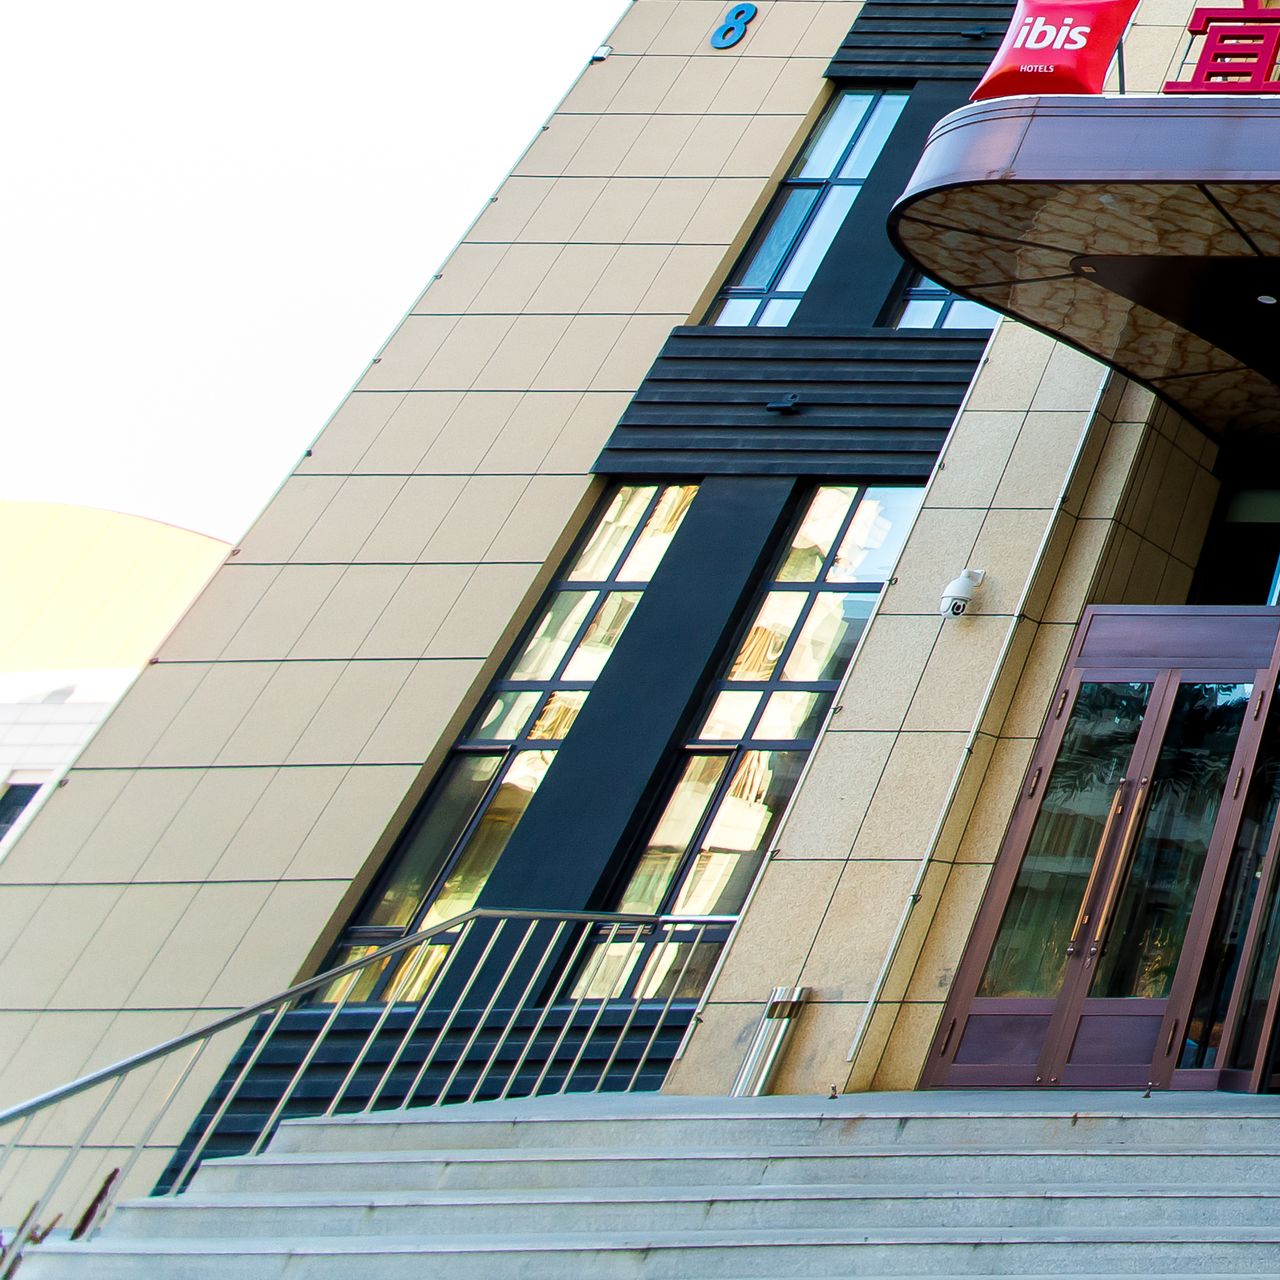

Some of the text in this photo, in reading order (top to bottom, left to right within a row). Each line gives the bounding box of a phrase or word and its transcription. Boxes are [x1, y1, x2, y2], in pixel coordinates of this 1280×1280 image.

[710, 3, 758, 50] 8
[1012, 16, 1091, 51] ibis
[1019, 64, 1055, 73] HOTELS
